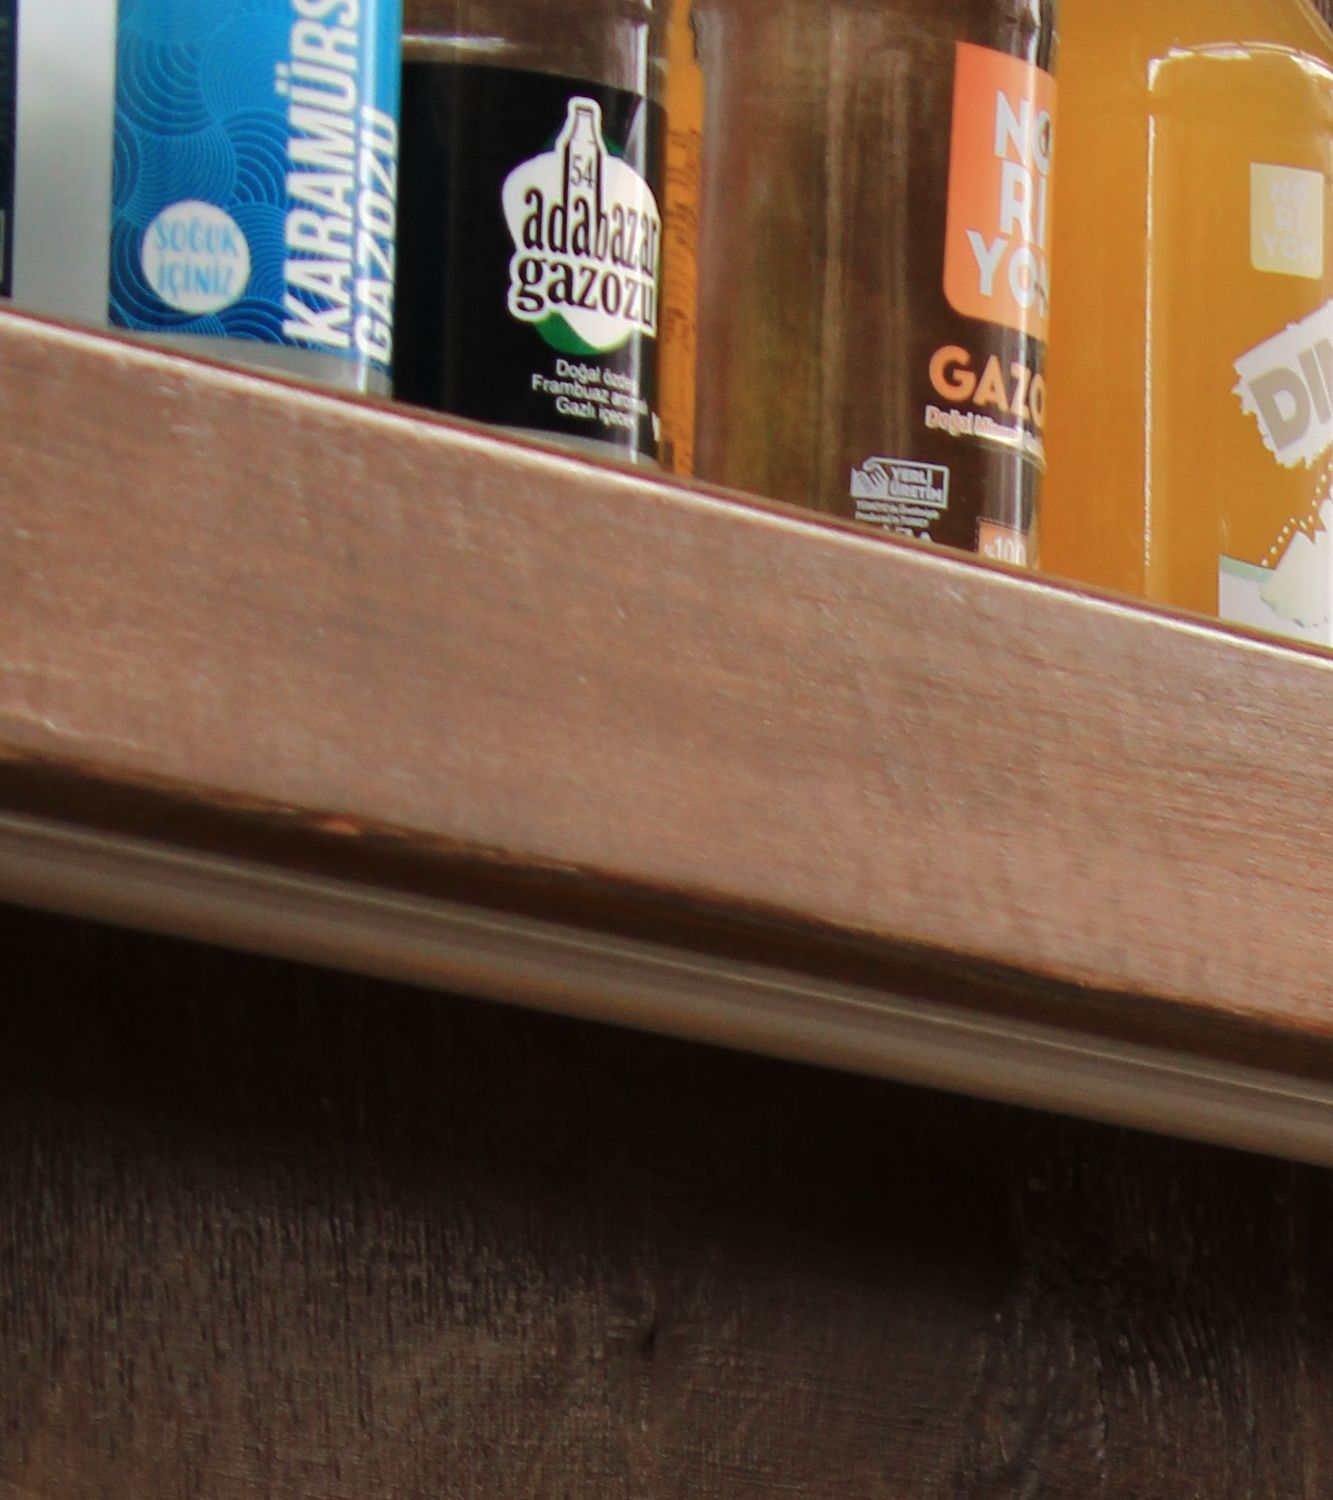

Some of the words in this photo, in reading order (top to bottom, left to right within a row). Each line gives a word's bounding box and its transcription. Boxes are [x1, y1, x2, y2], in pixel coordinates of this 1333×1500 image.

[569, 157, 595, 190] 54
[154, 214, 238, 257] SOĞUK
[156, 254, 234, 298] İÇİNİZ
[516, 256, 655, 327] gazozu
